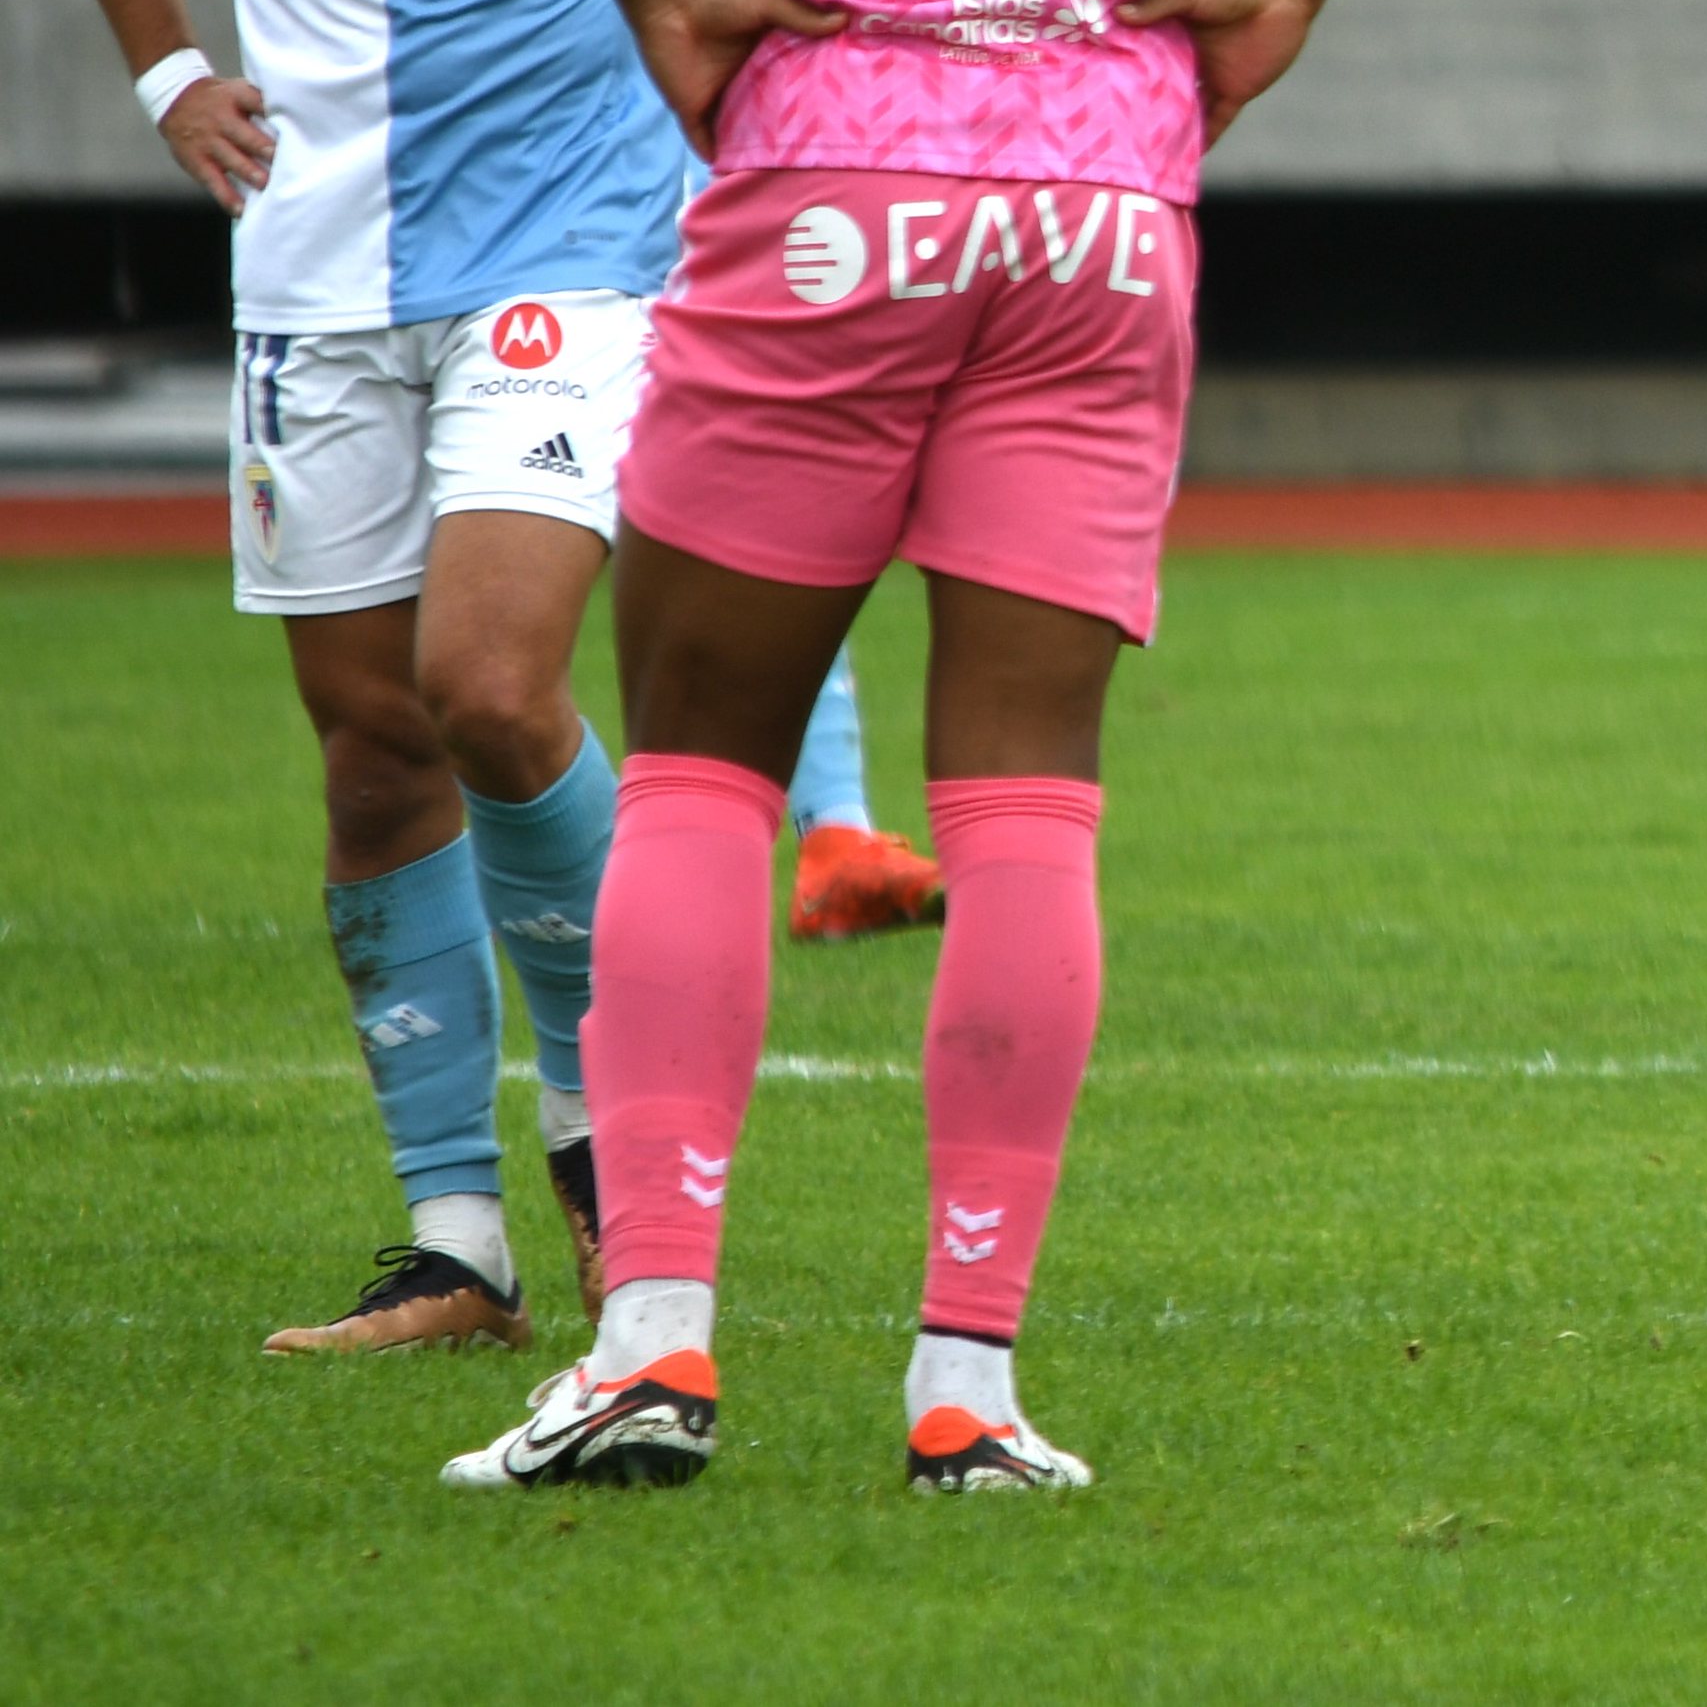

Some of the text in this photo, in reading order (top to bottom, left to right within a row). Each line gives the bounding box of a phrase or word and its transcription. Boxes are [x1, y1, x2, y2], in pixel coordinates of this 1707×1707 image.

[859, 13, 1036, 45] Canarias
[887, 190, 1160, 301] EAVE
[468, 375, 587, 400] motorola
[520, 456, 584, 479] adidas
